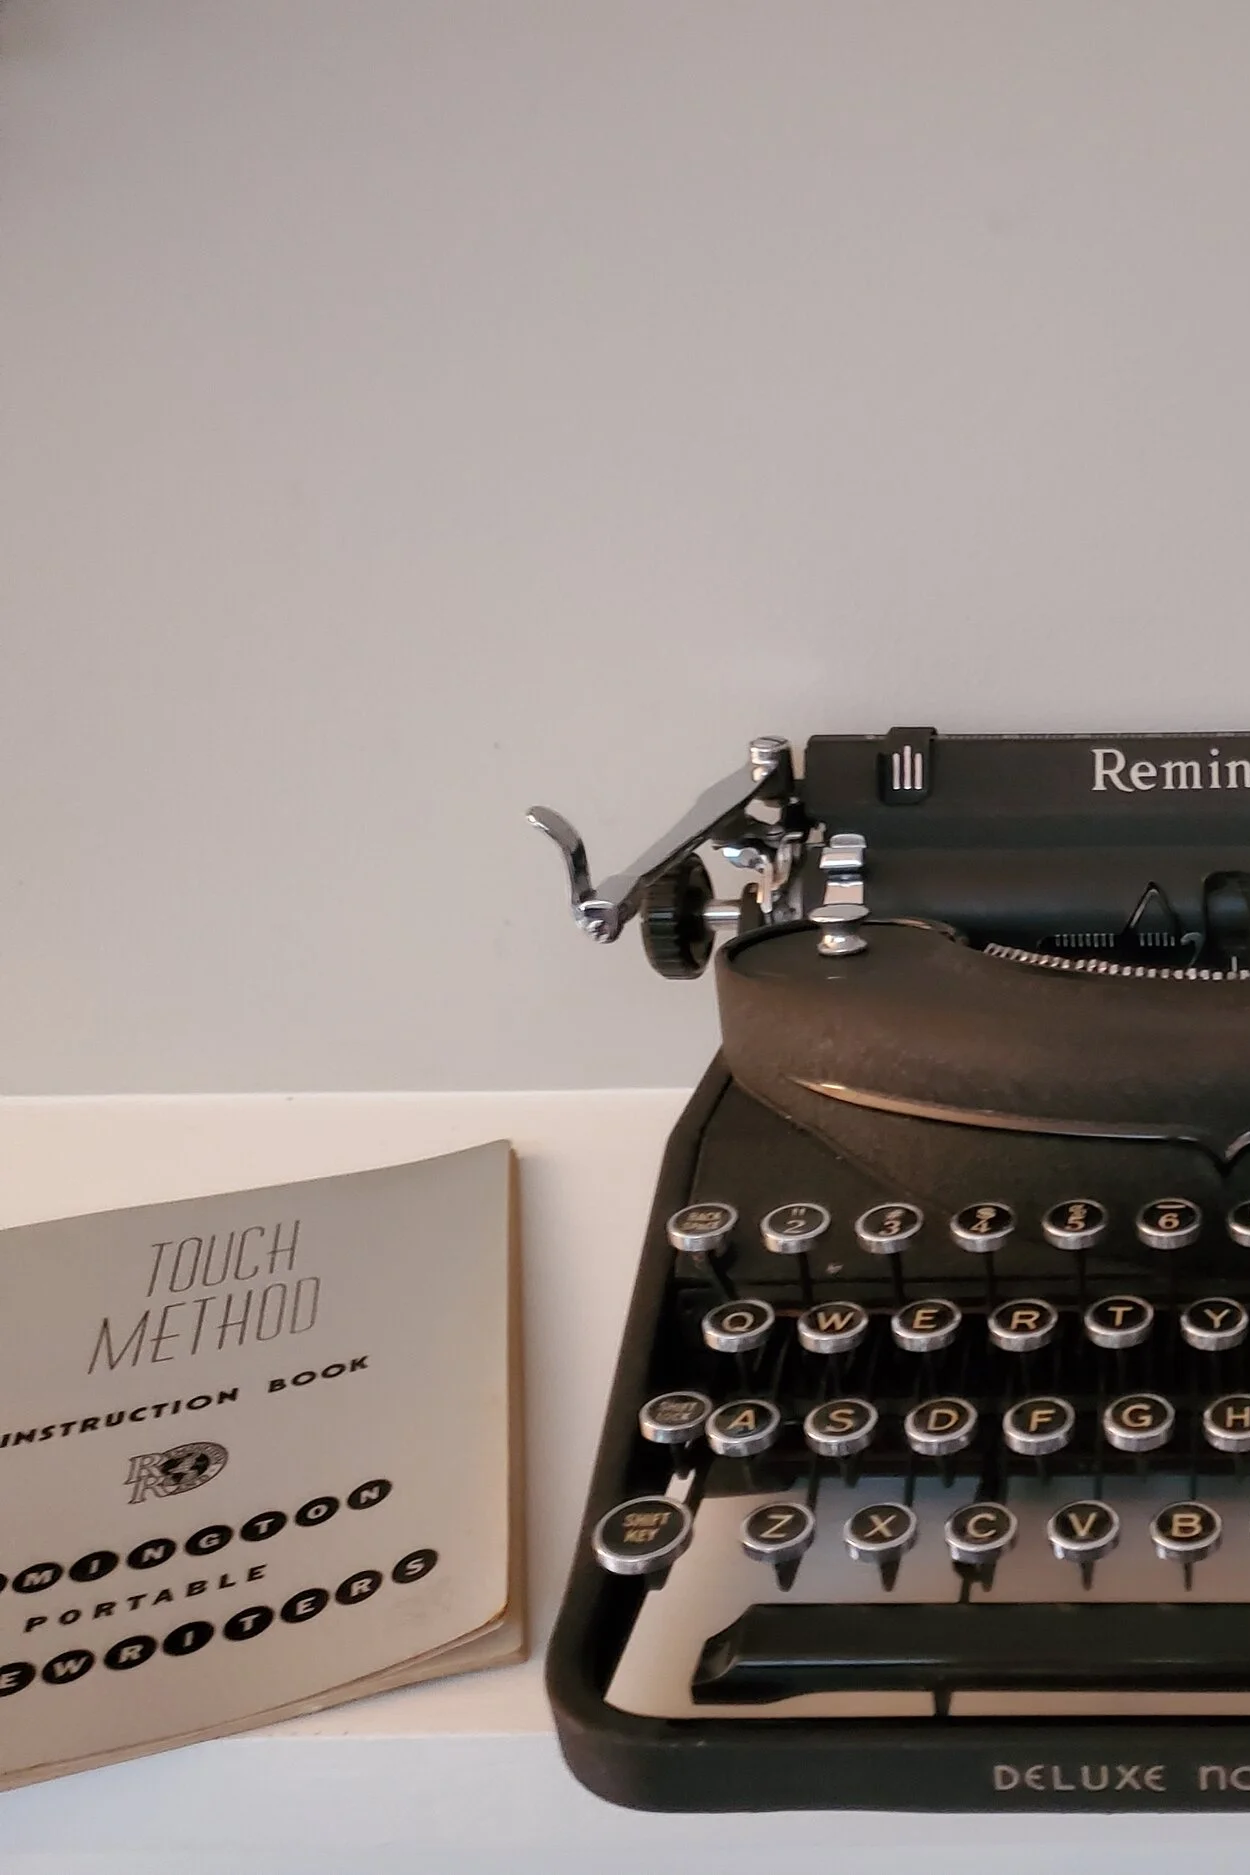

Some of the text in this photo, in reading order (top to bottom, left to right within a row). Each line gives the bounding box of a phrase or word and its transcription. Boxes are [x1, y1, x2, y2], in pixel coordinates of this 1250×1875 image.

[783, 1220, 806, 1234] 2
[879, 1220, 902, 1236] 3
[969, 1219, 992, 1233] 4
[1065, 1216, 1086, 1231] 5
[1159, 1213, 1180, 1229] 6
[146, 1220, 300, 1297] TOUCH
[87, 1276, 320, 1375] METHOD
[722, 1311, 754, 1332] Q
[816, 1311, 855, 1331] W
[912, 1308, 940, 1329] E
[1010, 1310, 1041, 1330] R
[1107, 1306, 1134, 1327] T
[1203, 1308, 1231, 1329] Y
[0, 1355, 369, 1449] INSTRUCTION BOOK
[728, 1409, 756, 1430] A
[824, 1409, 855, 1432] S
[927, 1409, 959, 1431] D
[1028, 1409, 1056, 1432] F
[1121, 1403, 1153, 1428] G
[1226, 1406, 1250, 1428] H
[622, 1511, 671, 1527] SHIFT
[759, 1514, 795, 1538] Z
[863, 1514, 898, 1538] X
[966, 1514, 997, 1538] C
[1068, 1512, 1098, 1536] V
[1171, 1513, 1202, 1537] B
[623, 1528, 659, 1543] KEY
[23, 1564, 268, 1634] PORTABLE
[993, 1764, 1167, 1792] DELUXE
